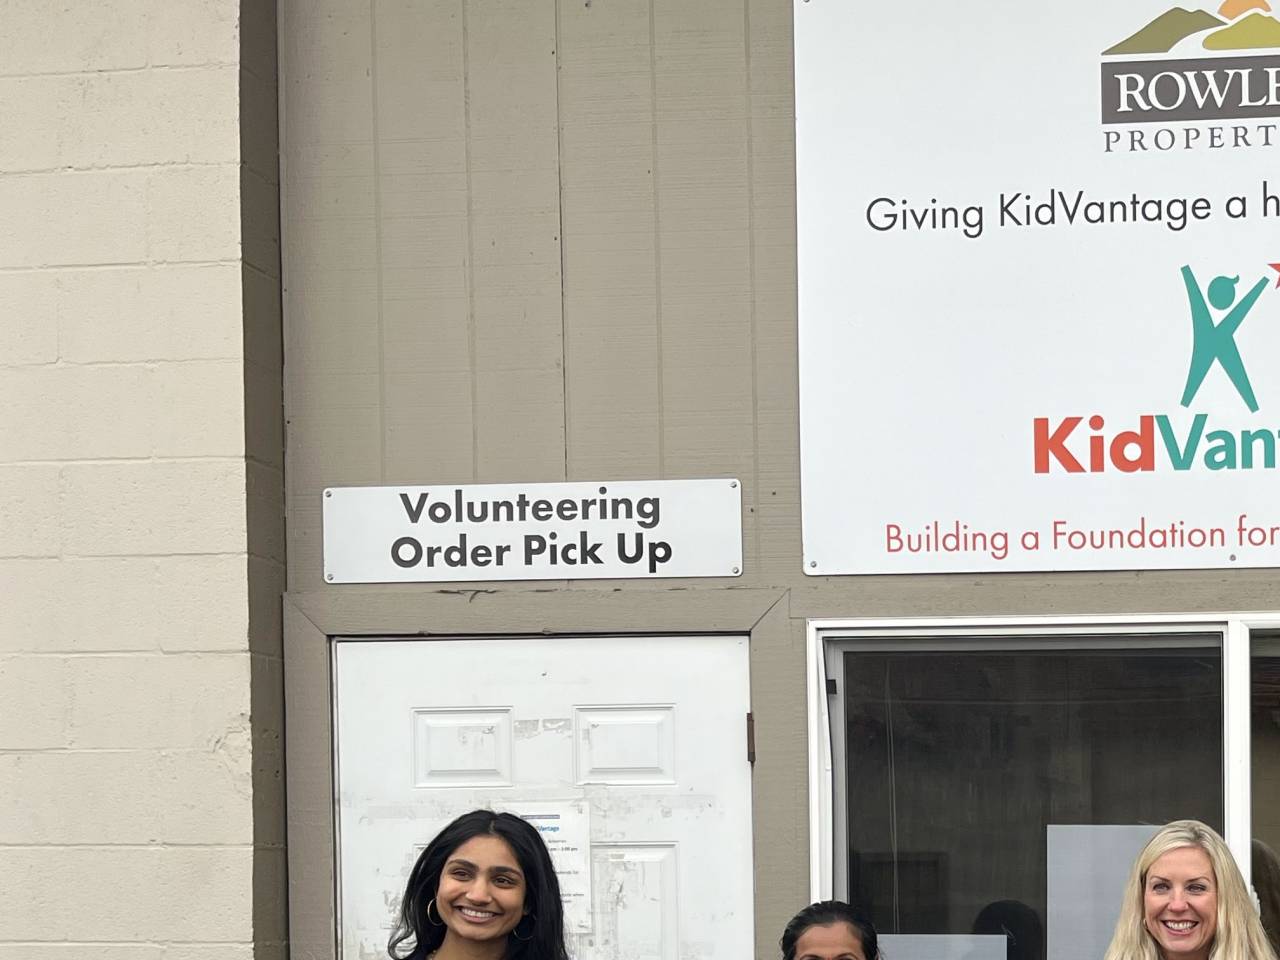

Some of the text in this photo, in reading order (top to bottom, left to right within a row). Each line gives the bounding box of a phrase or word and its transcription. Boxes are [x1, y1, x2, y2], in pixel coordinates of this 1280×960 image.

[867, 197, 984, 239] Giving
[999, 188, 1212, 232] KidVantage
[1225, 196, 1247, 219] a
[400, 486, 661, 528] Volunteering
[390, 530, 673, 574] Order Pick Up
[886, 521, 1009, 560] Building
[1020, 531, 1040, 551] a
[1053, 518, 1227, 553] Foundation
[1236, 514, 1280, 547] for
